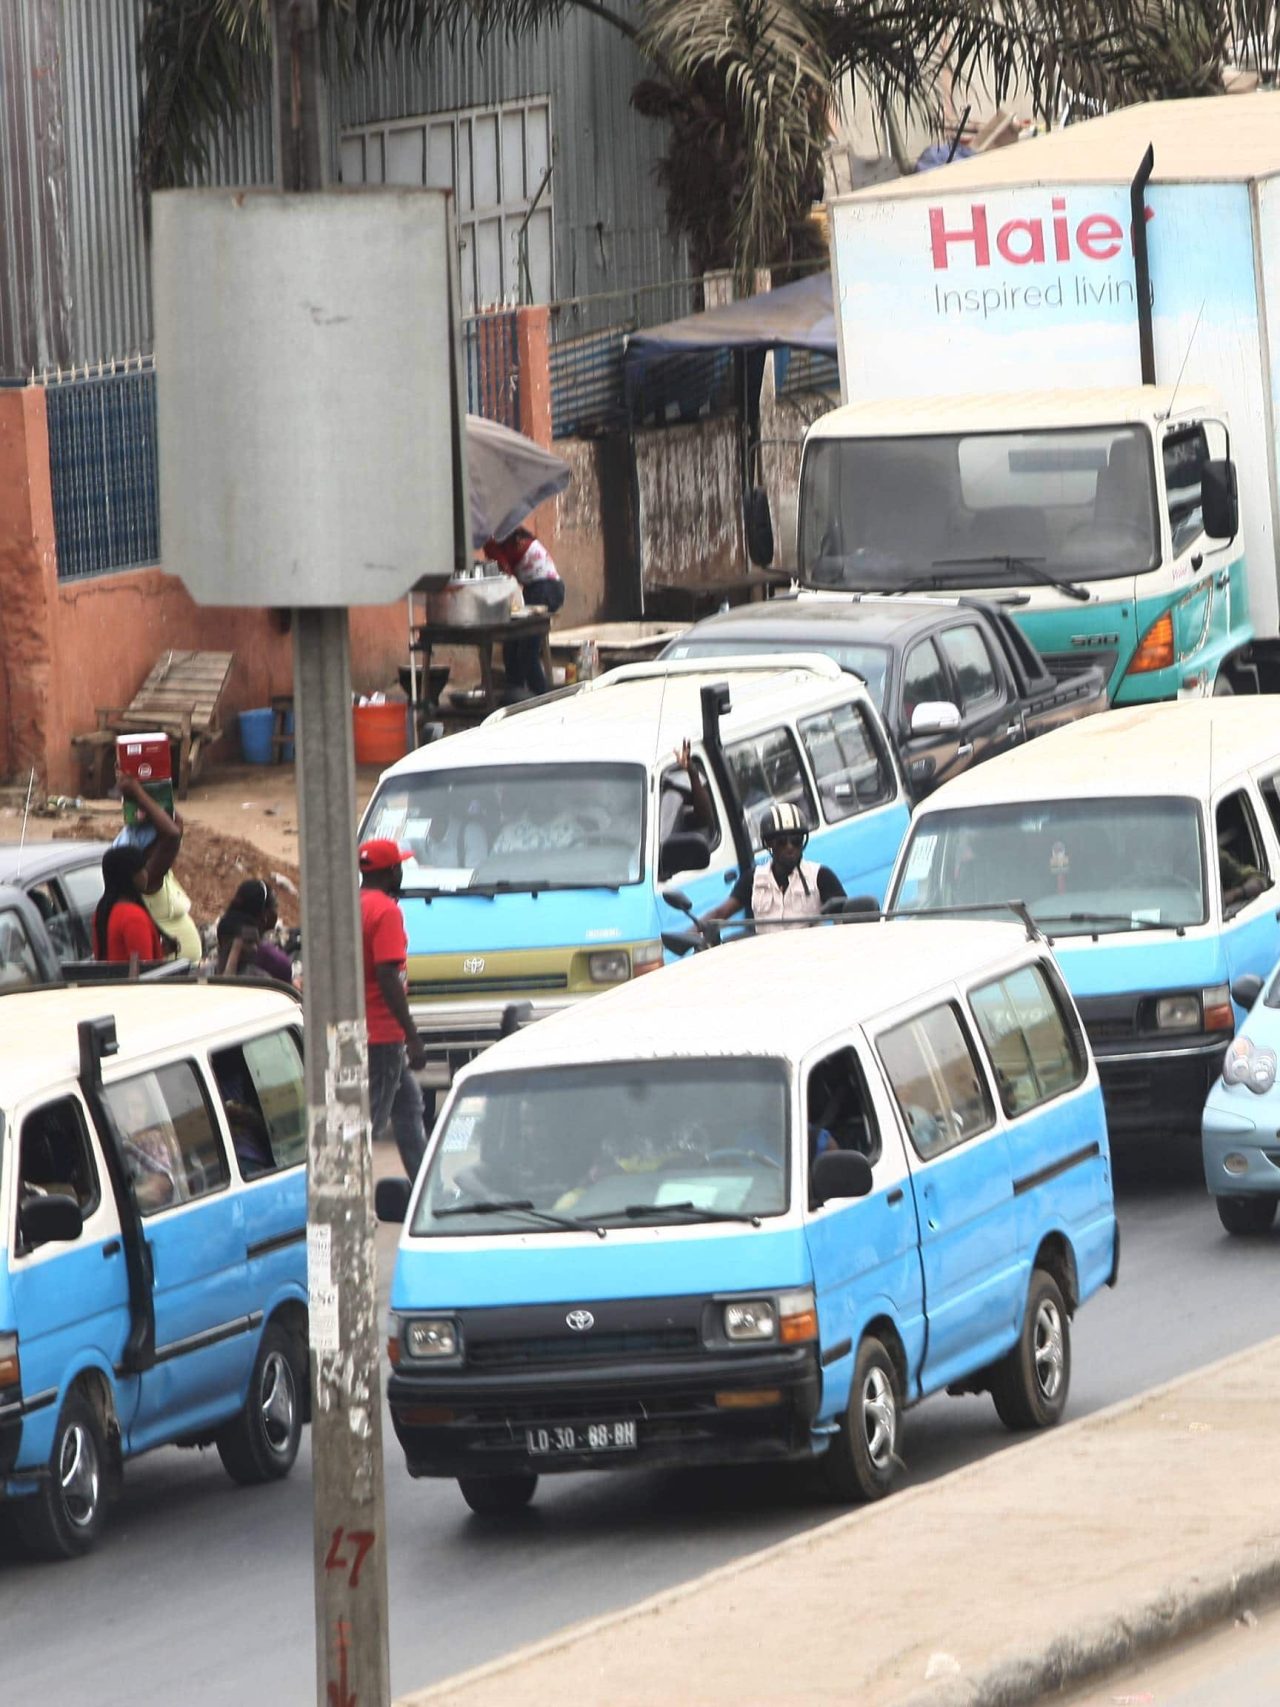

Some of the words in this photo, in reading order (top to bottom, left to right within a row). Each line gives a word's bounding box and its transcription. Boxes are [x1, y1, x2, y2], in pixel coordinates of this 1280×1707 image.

[929, 197, 1155, 270] Haie
[935, 276, 1063, 320] Inspired
[1075, 274, 1154, 309] livin
